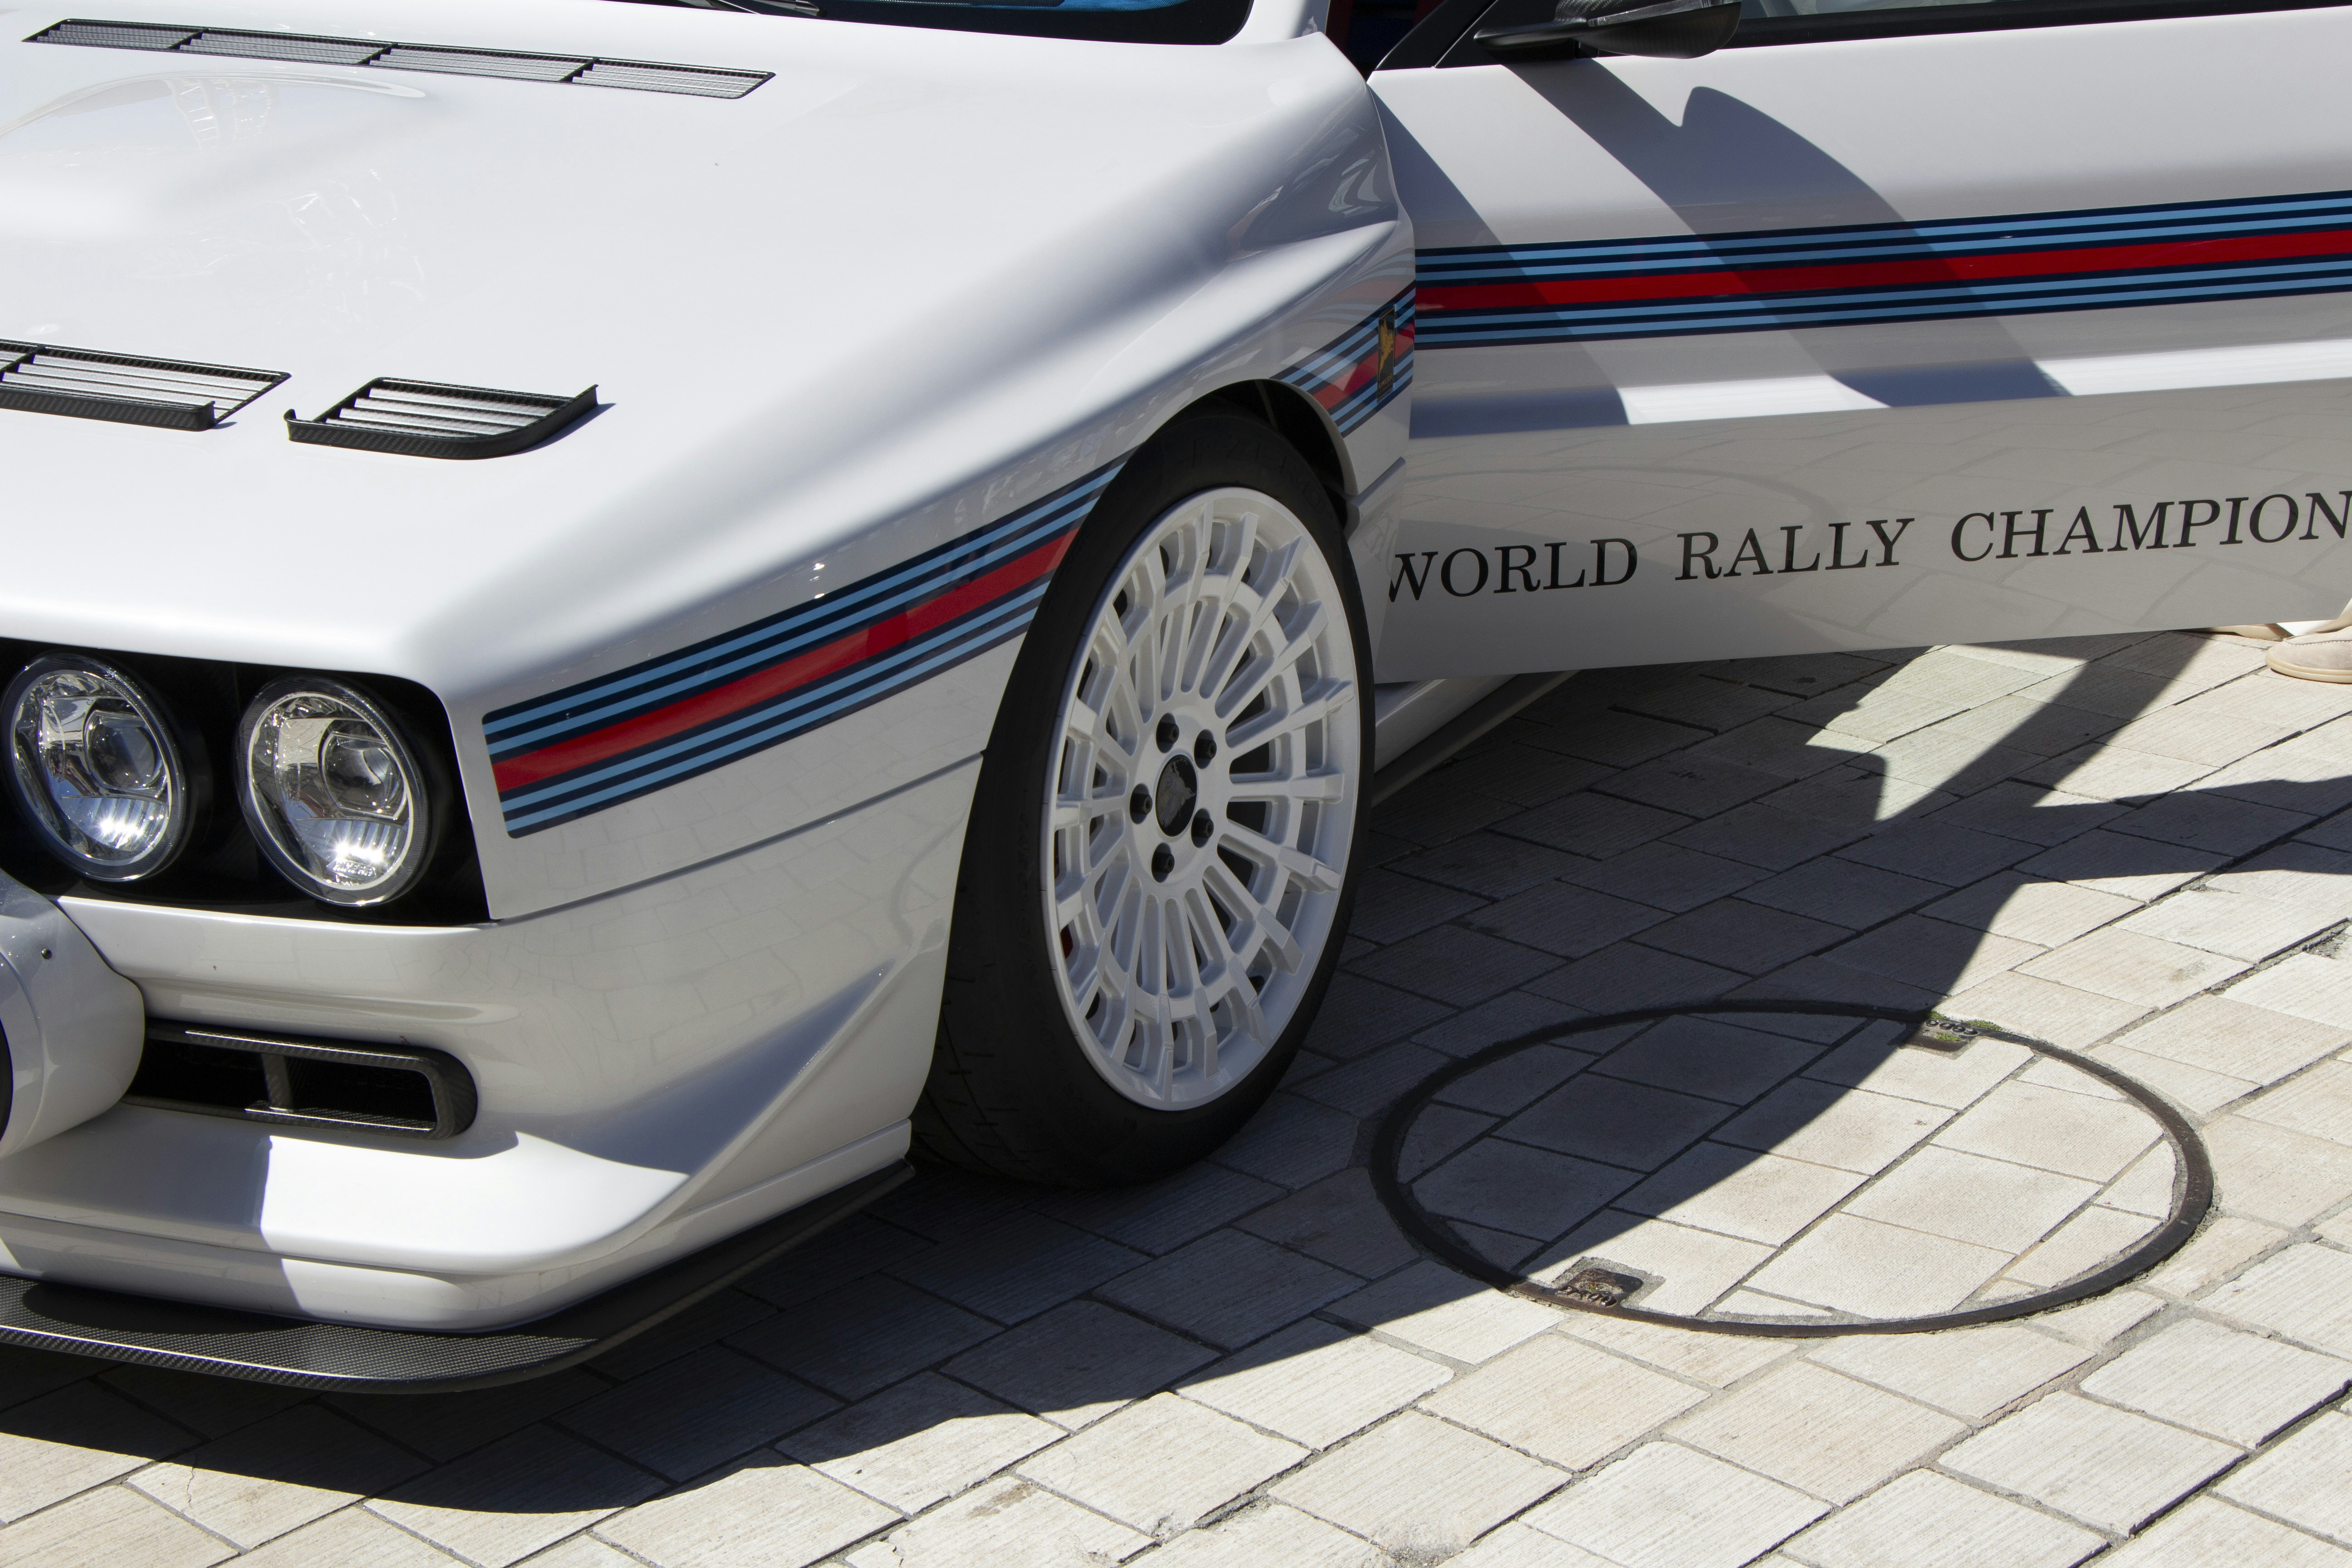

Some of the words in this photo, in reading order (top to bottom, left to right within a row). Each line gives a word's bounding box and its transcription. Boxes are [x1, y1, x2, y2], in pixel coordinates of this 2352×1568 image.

[1389, 539, 1637, 603] WORLD
[1675, 519, 1914, 580] RALLY
[1952, 491, 2352, 561] CHAMPION
